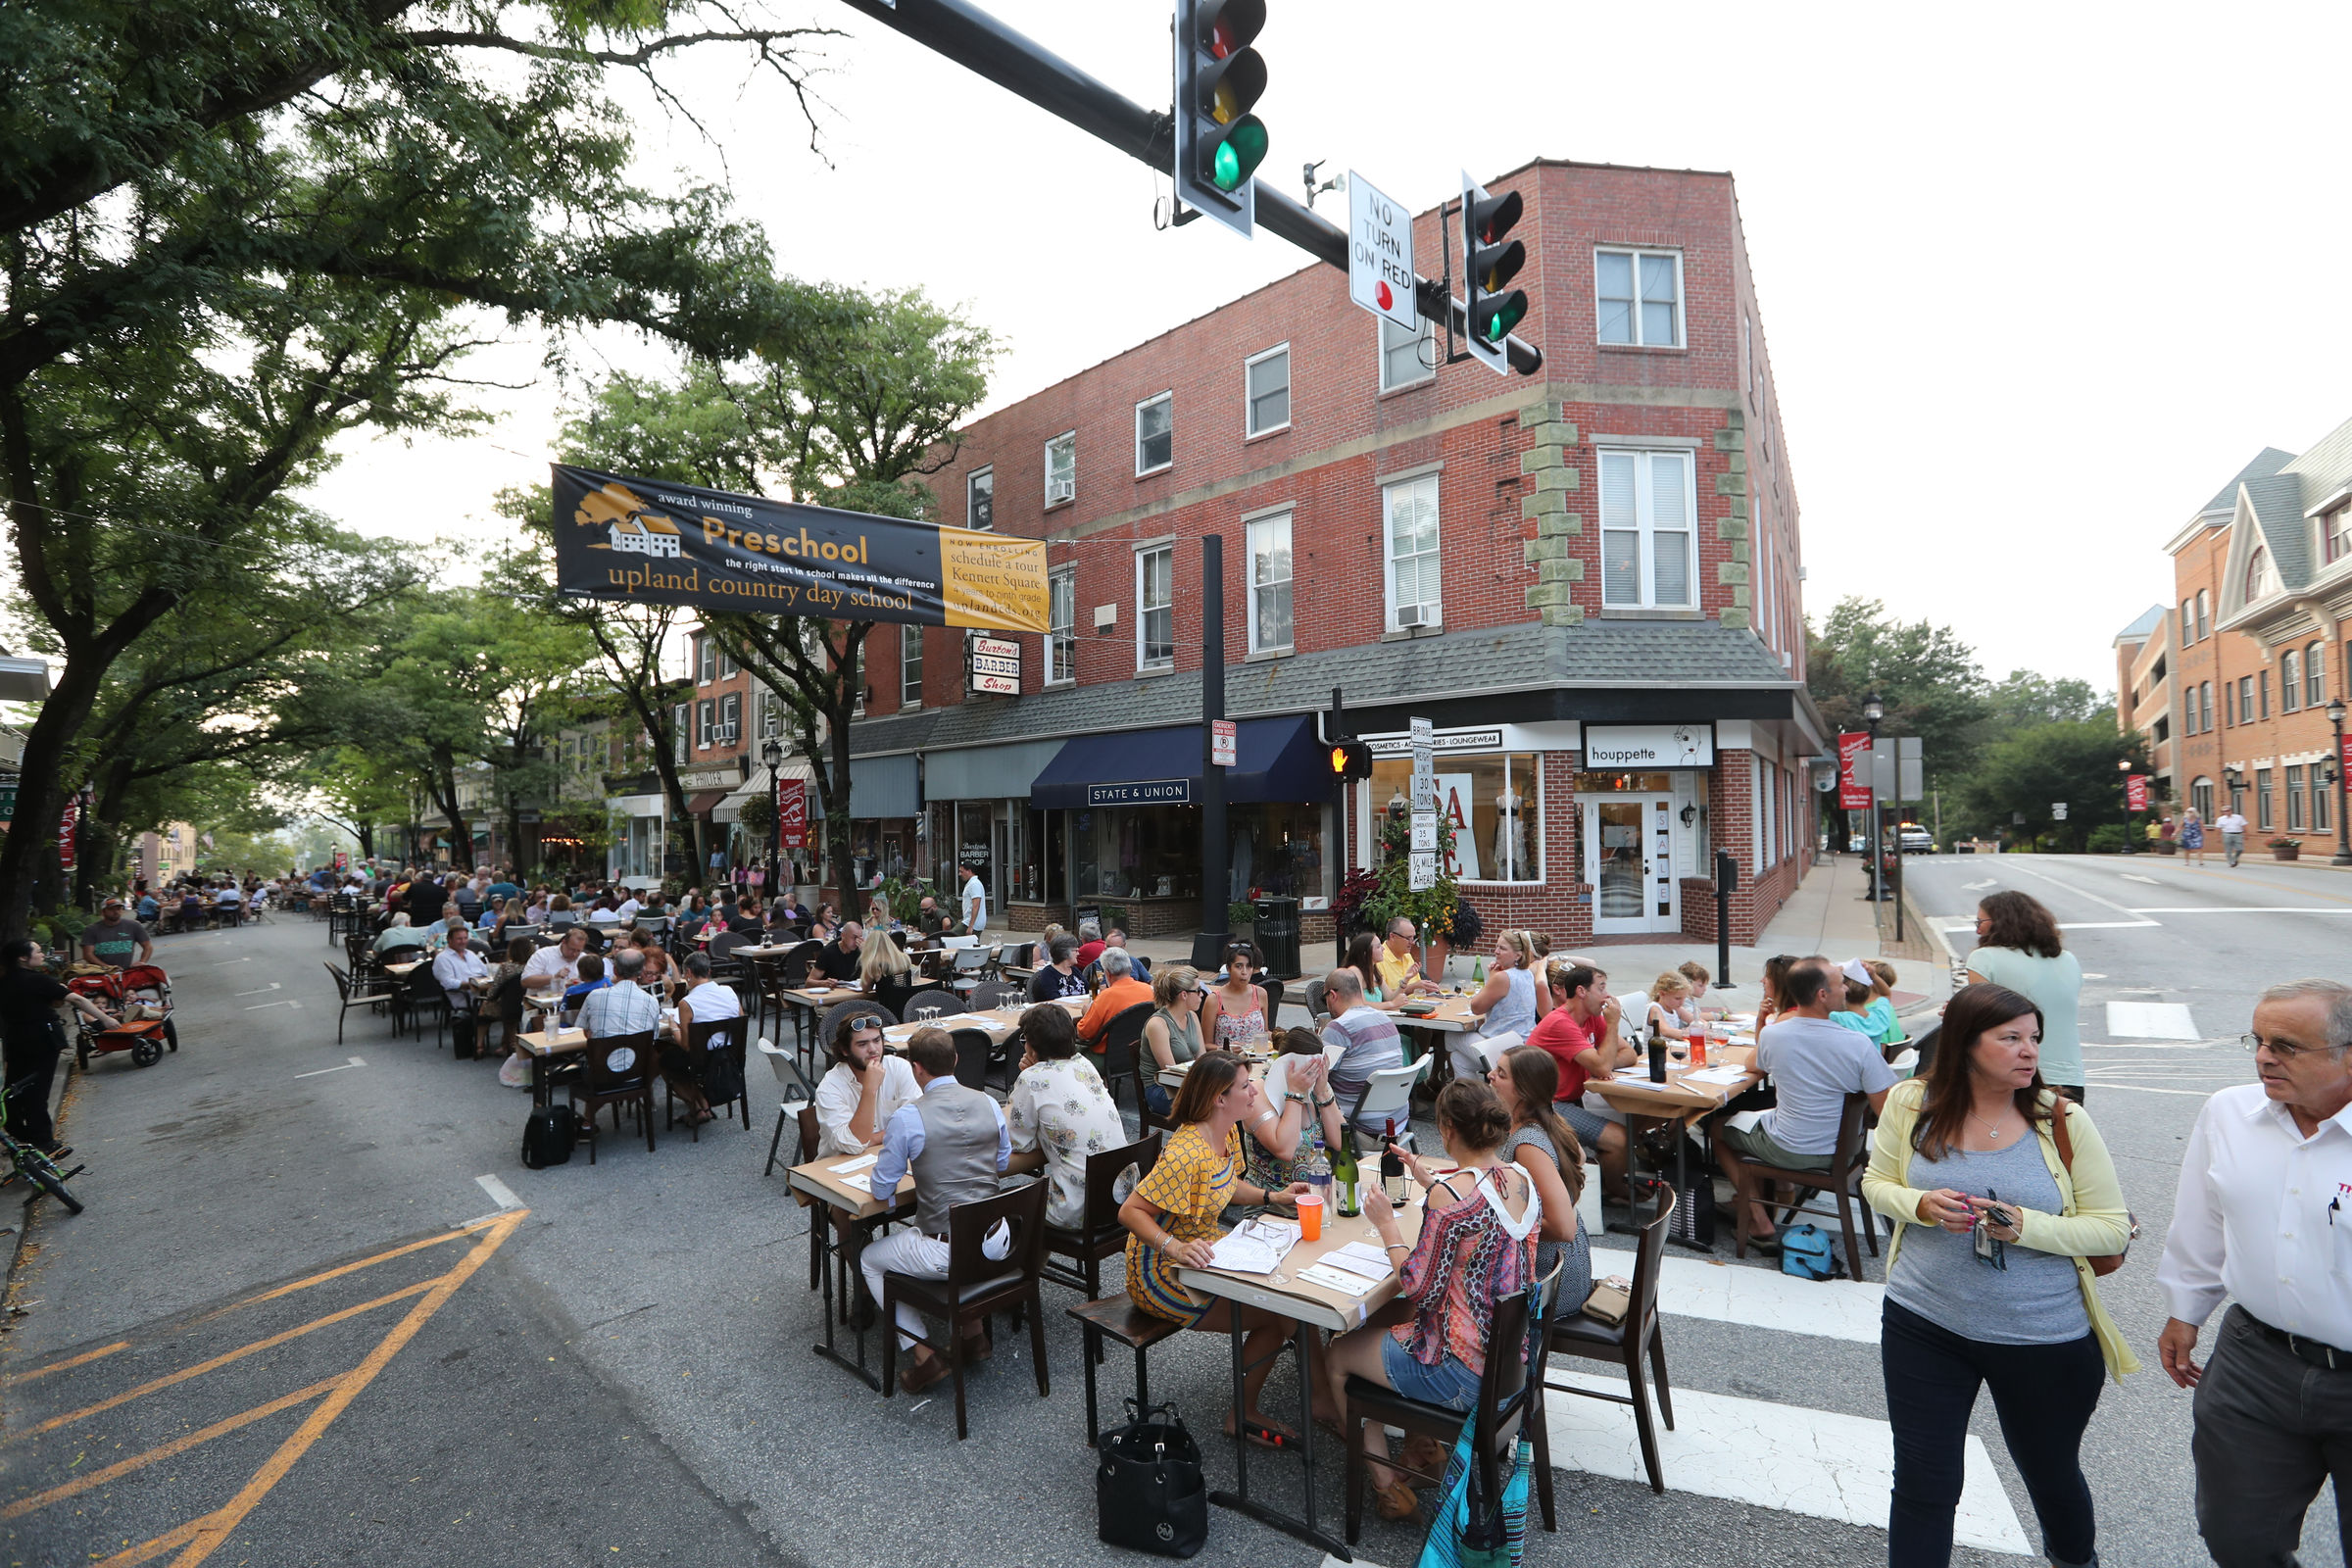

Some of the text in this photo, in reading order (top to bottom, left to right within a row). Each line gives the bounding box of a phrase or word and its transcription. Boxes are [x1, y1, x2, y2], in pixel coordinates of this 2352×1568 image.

[1369, 192, 1393, 226] NO
[1363, 219, 1400, 260] TURN
[1354, 241, 1411, 290] ON RED
[658, 493, 754, 518] award winning
[703, 515, 868, 565] Preschool
[979, 542, 1039, 558] ENROLLING
[951, 550, 1003, 568] schedule
[1015, 562, 1040, 573] tour
[725, 558, 935, 589] the right start in school makes all the difference
[952, 566, 1042, 591] Kennett Square
[609, 563, 913, 611] upland country day school
[961, 587, 983, 597] years
[986, 589, 995, 598] to
[997, 590, 1017, 600] ninth
[1018, 593, 1042, 604] grade
[977, 639, 1018, 657] Burton's
[975, 658, 1018, 674] BARBER
[983, 677, 1012, 692] Shop
[1412, 725, 1432, 738] BRIDGE
[1449, 735, 1497, 745] LOUNGEWEAR
[1415, 751, 1432, 762] WEIGHT
[1592, 747, 1656, 763] houppette
[1418, 762, 1430, 774] LIMIT
[695, 768, 723, 785] PHILTER
[1419, 777, 1429, 790] 30
[1094, 786, 1183, 800] STATE & UNION
[1417, 793, 1432, 807] TONS
[1419, 829, 1427, 838] 35
[1418, 839, 1431, 848] TONS
[1421, 857, 1434, 868] MILE
[1413, 874, 1433, 886] AHEAD
